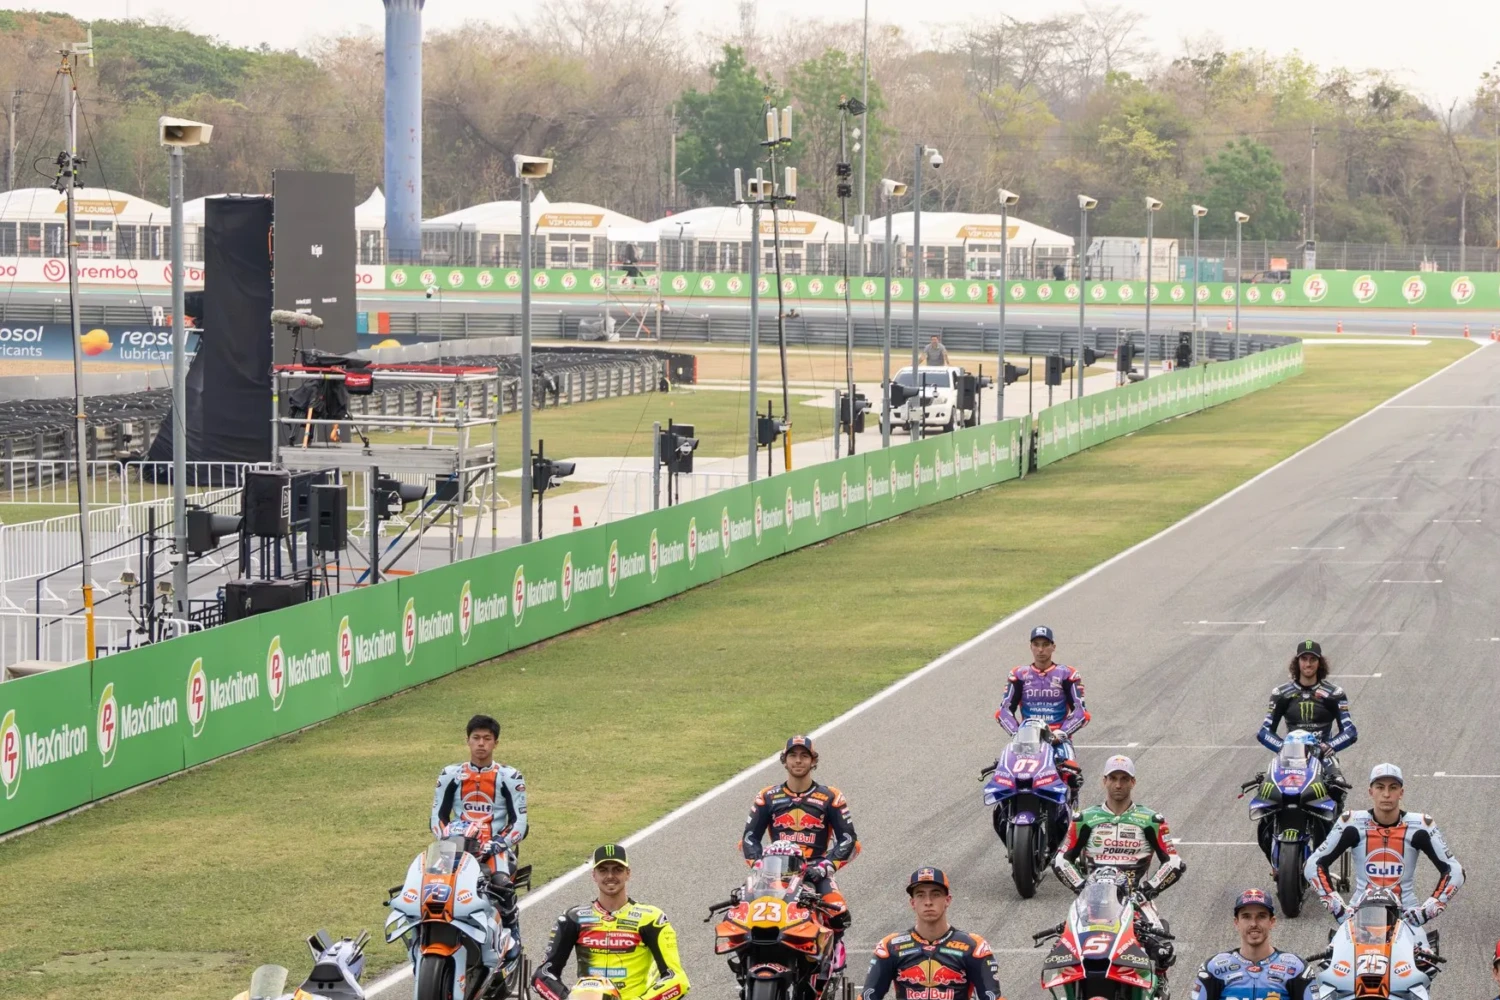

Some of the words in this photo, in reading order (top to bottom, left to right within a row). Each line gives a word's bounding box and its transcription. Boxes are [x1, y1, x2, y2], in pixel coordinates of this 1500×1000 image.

[574, 564, 604, 594] Maxnitron
[526, 577, 557, 608] Maxnitron
[473, 593, 507, 626] Maxnitron
[418, 611, 454, 644] Maxnitron
[355, 629, 396, 665] Maxnitron
[287, 650, 331, 687] Maxnitron
[210, 670, 259, 712] Maxnitron
[1026, 688, 1061, 699] prima
[121, 697, 178, 740] Maxnitron
[1264, 733, 1283, 748] YAMAHA
[1330, 733, 1350, 747] YAMAHA
[25, 724, 87, 770] Maxnitron
[1013, 759, 1040, 773] 07
[463, 802, 493, 813] Gulf
[779, 832, 796, 842] Red
[797, 832, 816, 844] Bull
[1104, 837, 1142, 848] Castrol
[1095, 854, 1139, 862] HONDA
[1365, 863, 1403, 876] Gulf
[402, 891, 419, 902] Gulf
[456, 891, 474, 901] Gulf
[628, 910, 642, 918] HDI
[752, 901, 782, 923] 23
[582, 936, 635, 948] Enduro
[946, 941, 970, 951] KTM
[1083, 936, 1110, 954] 5
[1116, 938, 1135, 955] SENA
[1214, 966, 1227, 976] OLI
[1333, 963, 1351, 975] Gulf
[1394, 963, 1412, 975] Gulf
[906, 988, 928, 1000] Red
[929, 988, 954, 1000] Bull
